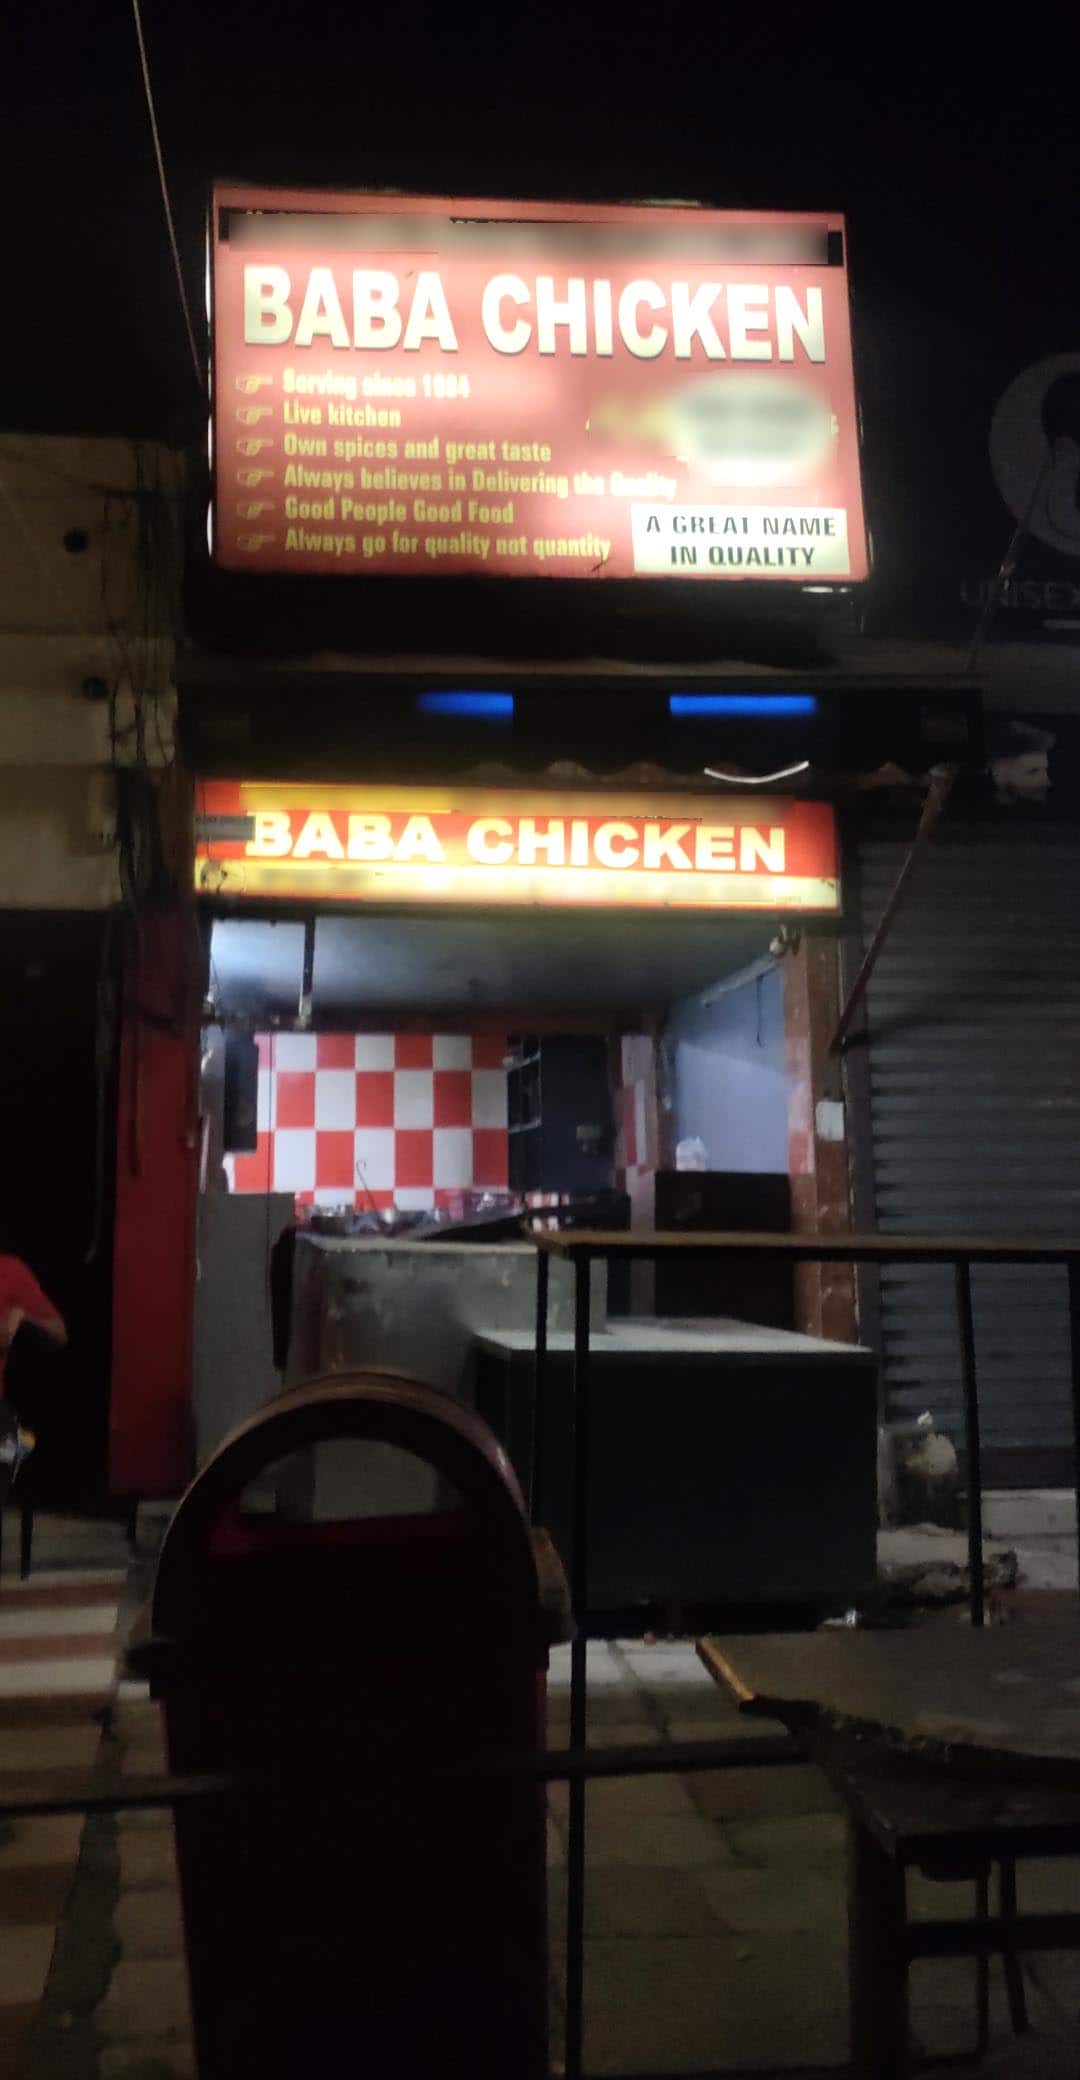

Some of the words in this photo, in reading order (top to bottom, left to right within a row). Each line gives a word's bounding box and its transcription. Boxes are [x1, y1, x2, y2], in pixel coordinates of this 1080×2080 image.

[244, 265, 458, 352] BABA
[481, 274, 826, 363] CHICKEN
[283, 368, 357, 400] Serving
[362, 372, 416, 398] since
[283, 400, 322, 425] Live
[328, 402, 401, 428] kitchen
[283, 432, 327, 457] Own
[334, 434, 398, 462] spices
[405, 435, 439, 459] and
[446, 440, 496, 464] great
[501, 440, 551, 462] taste
[284, 464, 354, 493] Always
[360, 466, 442, 491] believes
[449, 467, 466, 491] in
[472, 469, 569, 499] Delivering
[574, 471, 605, 495] the
[285, 496, 335, 521] Good
[341, 498, 407, 525] People
[414, 499, 462, 523] Good
[468, 500, 514, 524] Food
[646, 515, 661, 534] A
[672, 515, 749, 535] GREAT
[763, 517, 836, 537] NAME
[284, 528, 355, 557] Always
[362, 536, 386, 558] go
[392, 530, 418, 553] for
[425, 531, 490, 560] quality
[496, 536, 528, 556] not
[533, 533, 611, 560] quantity
[670, 545, 697, 567] IN
[708, 546, 815, 568] QUALITY
[245, 810, 447, 863] BABA
[466, 817, 786, 873] CHICKEN
